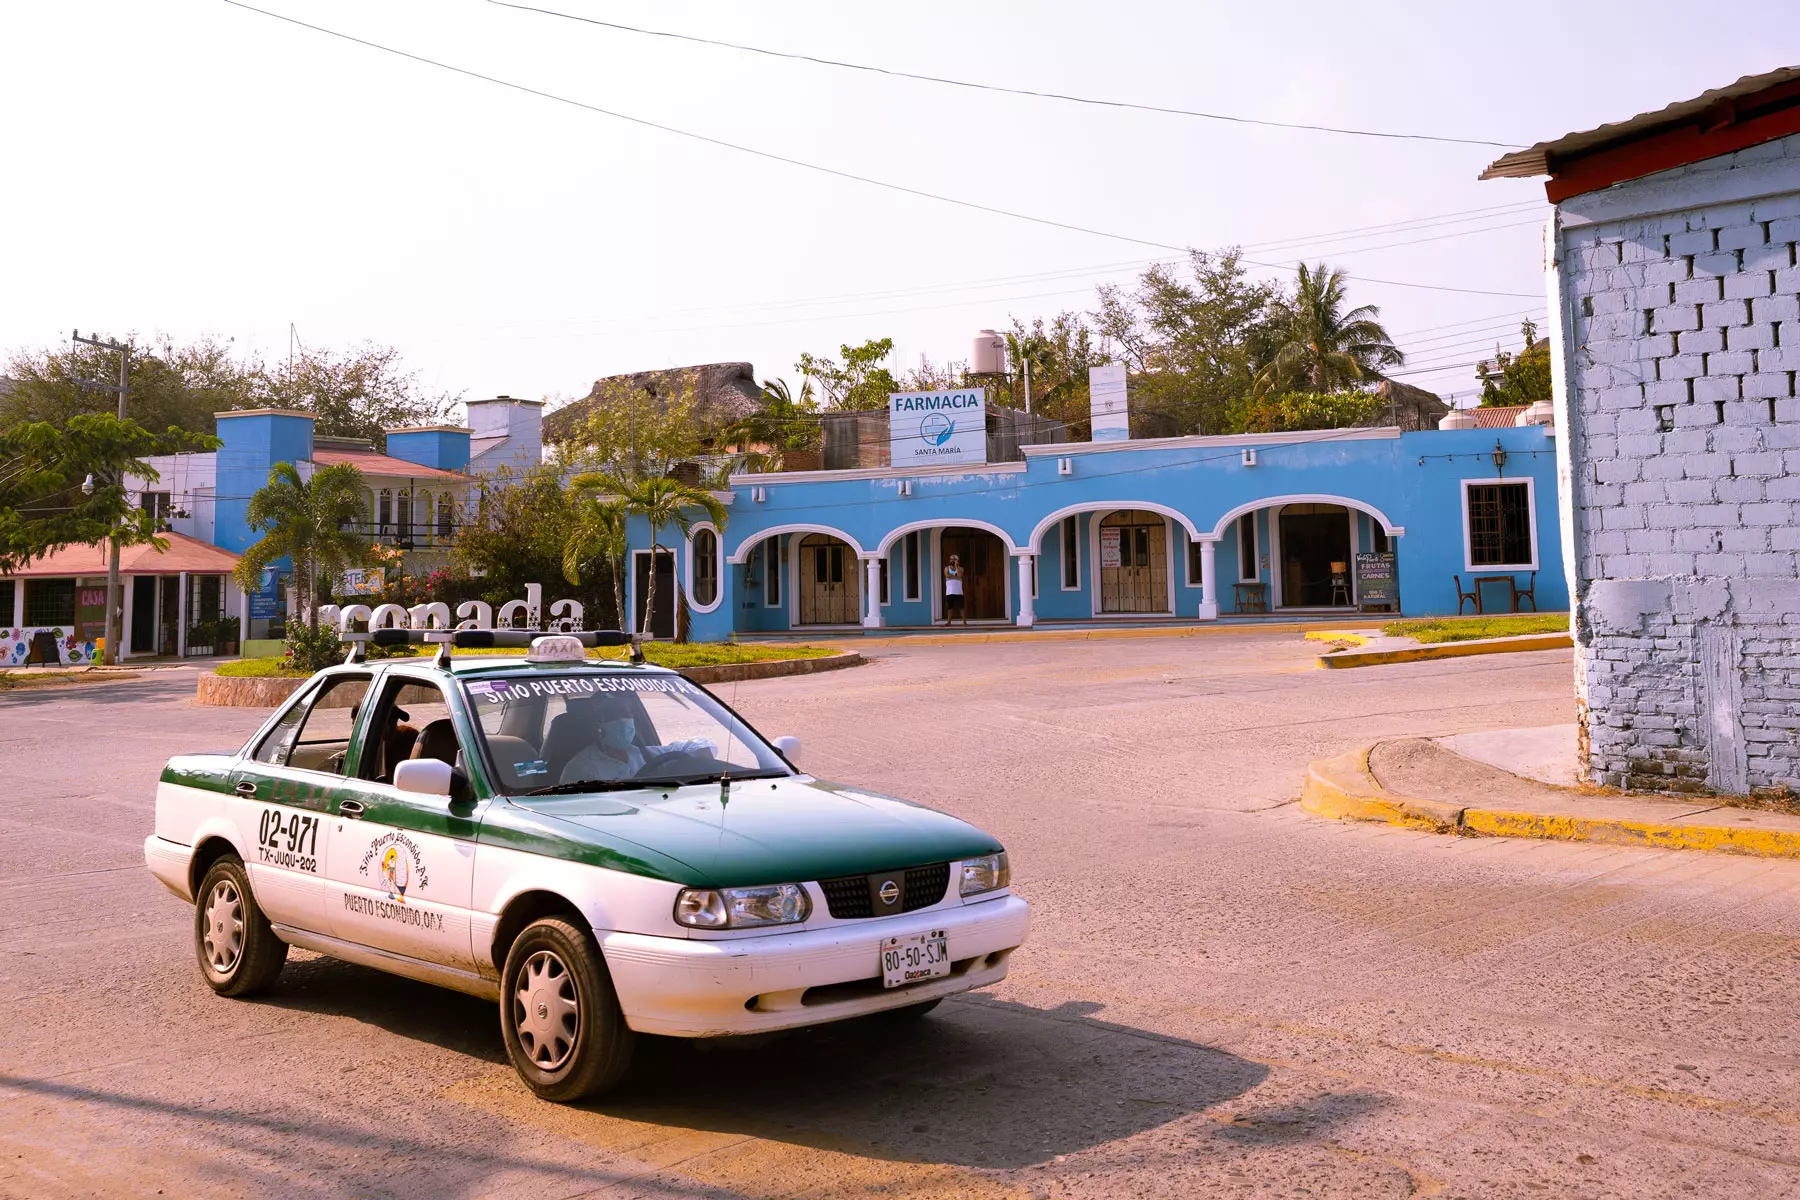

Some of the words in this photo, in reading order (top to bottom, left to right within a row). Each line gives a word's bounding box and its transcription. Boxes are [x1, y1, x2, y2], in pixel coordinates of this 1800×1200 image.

[895, 394, 978, 411] FARMACIA
[938, 446, 961, 455] MARÍA
[81, 590, 105, 606] CASA
[541, 641, 574, 654] TAXI
[529, 679, 593, 698] PUERTO
[595, 678, 675, 692] ESCONDIDO
[259, 808, 320, 857] 02-971
[258, 846, 317, 873] TX-JUQU-202
[344, 892, 374, 916] PUERTO
[884, 940, 949, 971] 80-50-SJM
[904, 968, 931, 980] Oaxaca
